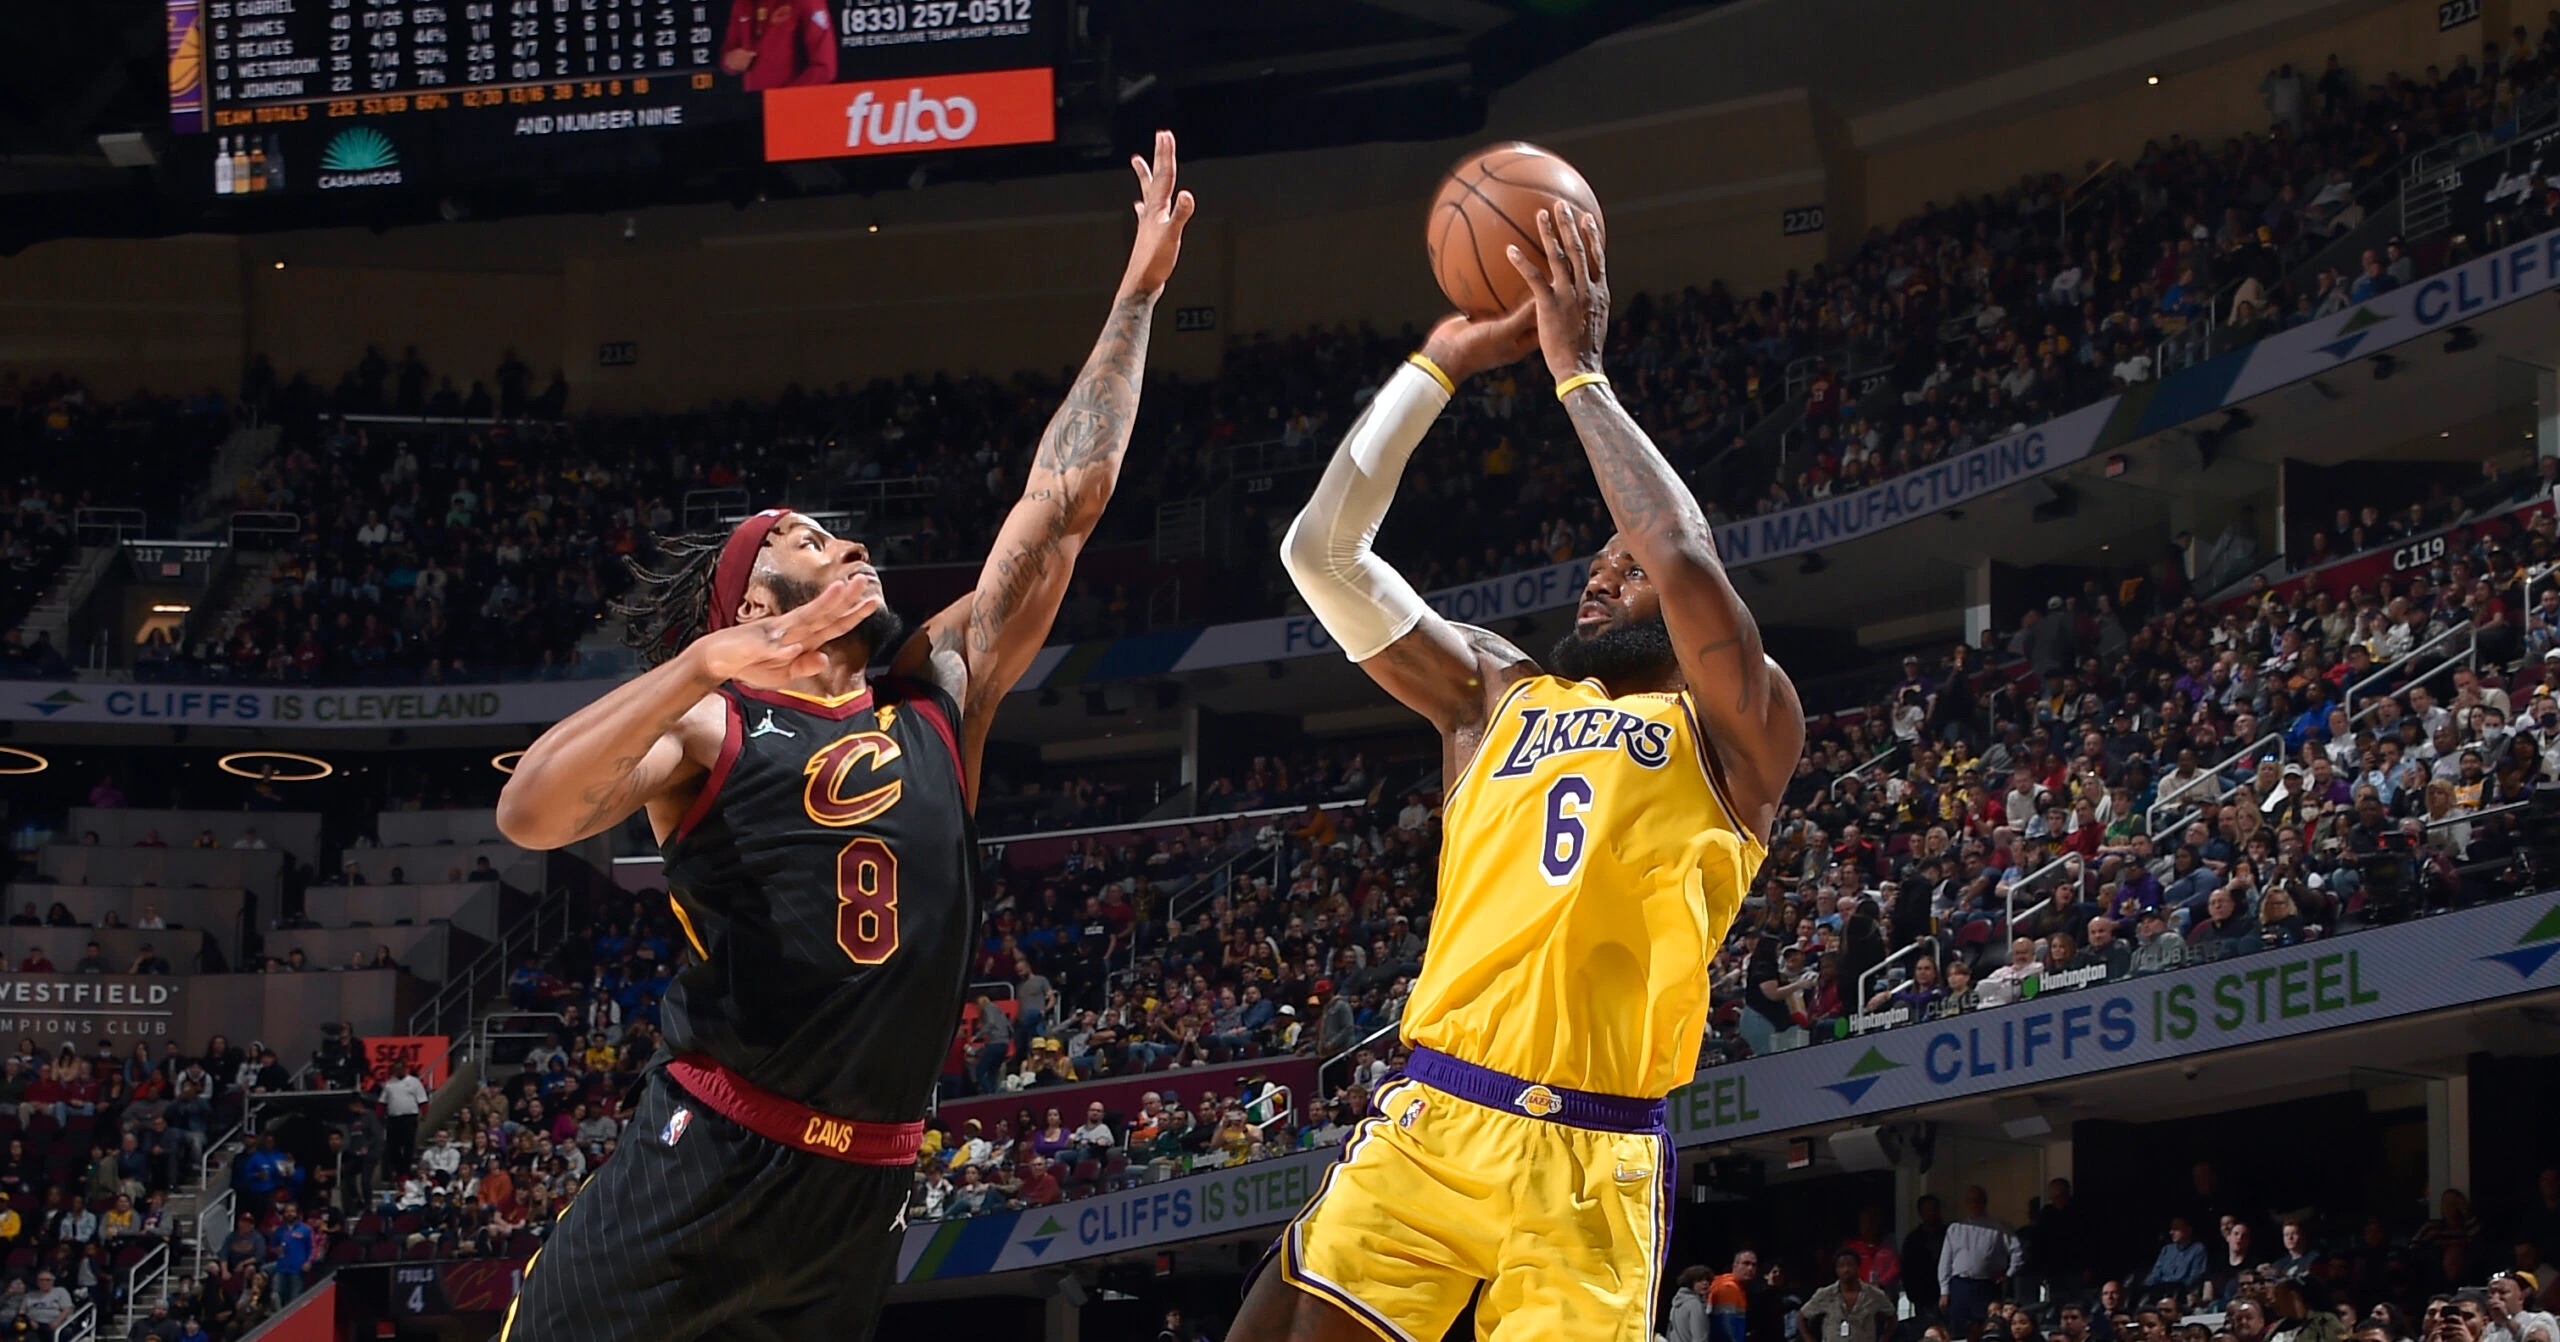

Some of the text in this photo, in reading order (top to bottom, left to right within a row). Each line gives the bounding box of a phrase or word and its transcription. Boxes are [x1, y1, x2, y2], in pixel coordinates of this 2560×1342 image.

[841, 0, 1032, 35] (833) 257-0512
[2441, 0, 2478, 27] 221
[215, 24, 228, 39] 6
[237, 20, 286, 38] JAMES
[237, 39, 294, 58] REAVES
[238, 57, 320, 79] WESTBROOK
[238, 79, 304, 99] JOHNSON
[215, 109, 253, 126] TEAM
[255, 104, 309, 123] TOTALS
[515, 105, 683, 136] AND NUMBER NINE
[846, 89, 977, 147] fubo
[318, 171, 402, 189] CASAMIGOS
[1785, 209, 1824, 234] 220
[2415, 234, 2560, 325] CLIF
[1177, 308, 1214, 329] 219
[1763, 431, 2047, 551] MANUFACTURING
[2410, 537, 2445, 567] 119
[1513, 572, 1556, 602] OF
[106, 690, 500, 722] CLIFFS IS CLEVELAND
[1489, 706, 1675, 780] LAKERS
[1538, 774, 1594, 887] 6
[837, 837, 898, 965] 8
[2039, 962, 2107, 992] Huntington
[106, 1020, 167, 1035] CLUB
[1926, 949, 2379, 1084] CLIFFS IS STEEL
[1668, 1075, 1759, 1134] TEEL
[804, 1116, 853, 1153] CAVS
[1078, 1188, 1192, 1246] CLIFFS
[1201, 1181, 1225, 1224] IS
[407, 1285, 425, 1313] 4
